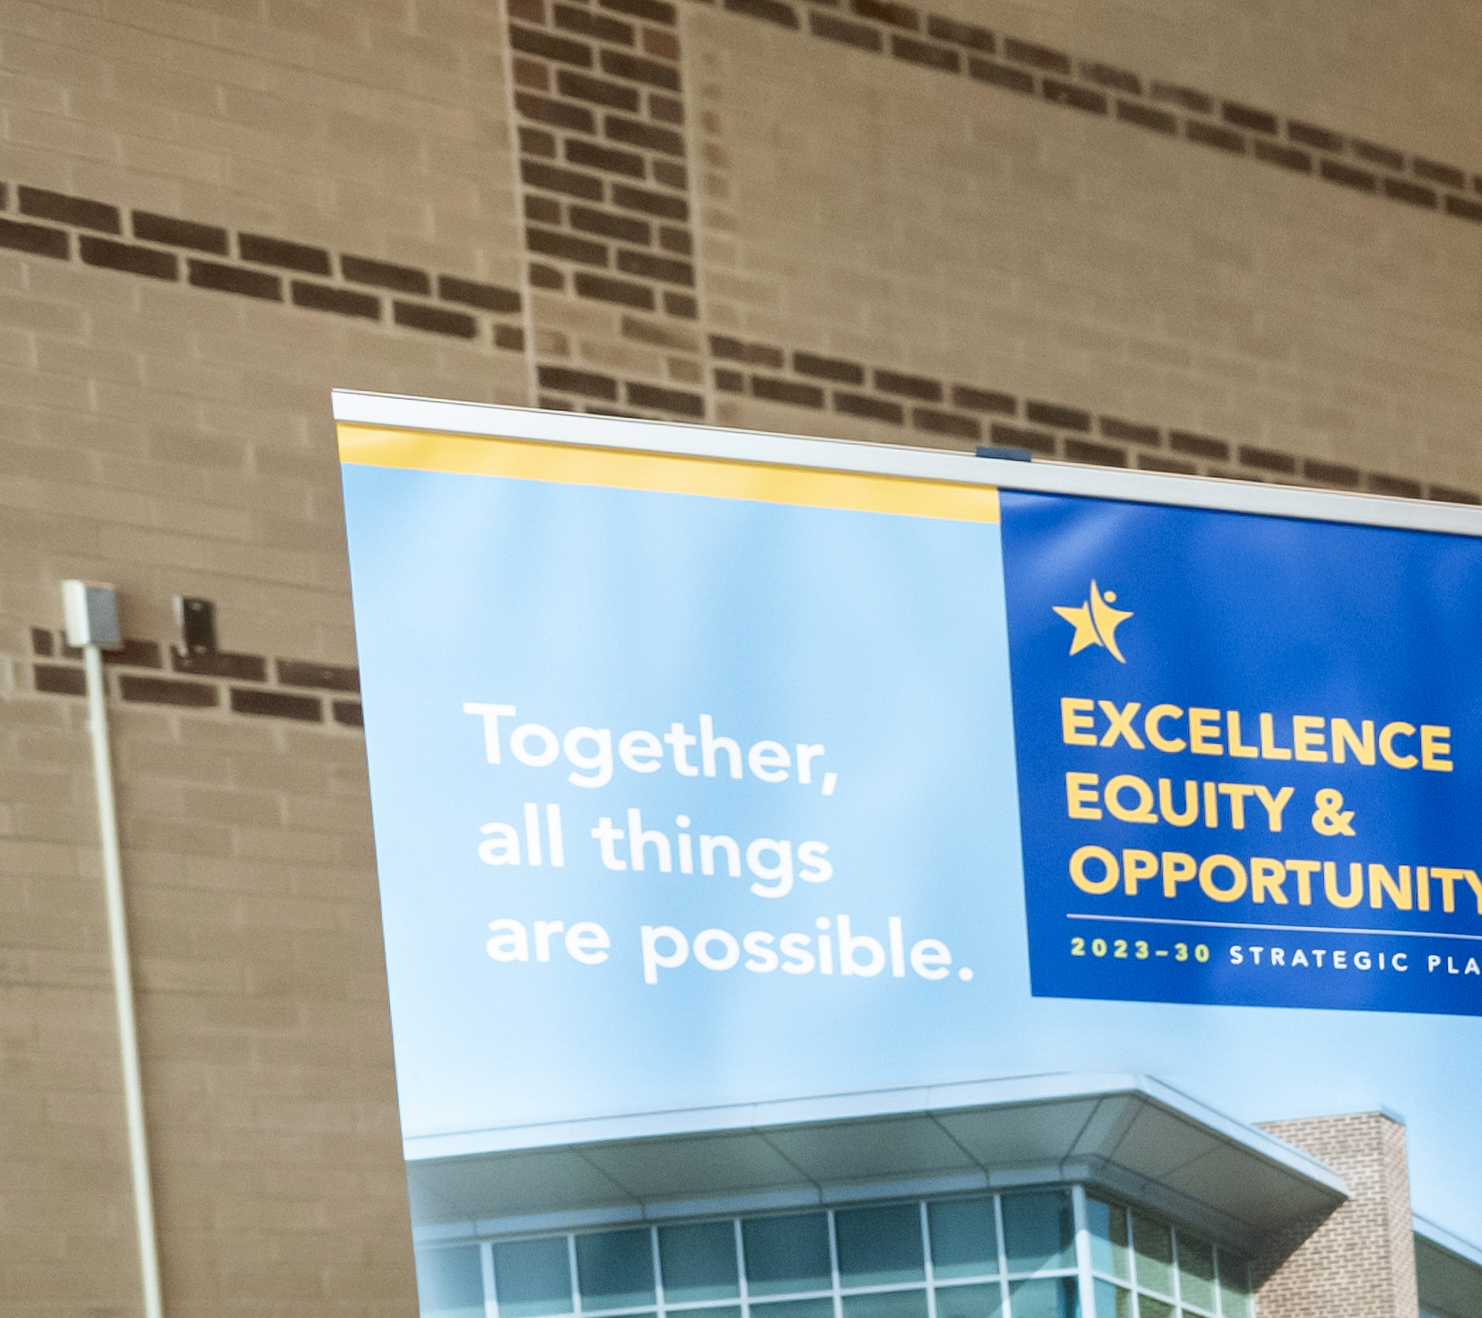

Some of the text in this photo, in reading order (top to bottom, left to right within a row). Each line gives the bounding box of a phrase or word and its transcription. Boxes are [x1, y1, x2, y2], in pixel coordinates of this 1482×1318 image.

[463, 702, 837, 796] Together,
[1061, 697, 1453, 772] EXCELLENCE
[1066, 772, 1356, 836] EQUITY &
[478, 802, 833, 898] all things
[486, 914, 974, 984] are possible.
[1071, 938, 1210, 963] 2023-30
[1230, 945, 1409, 972] STRATEGIC
